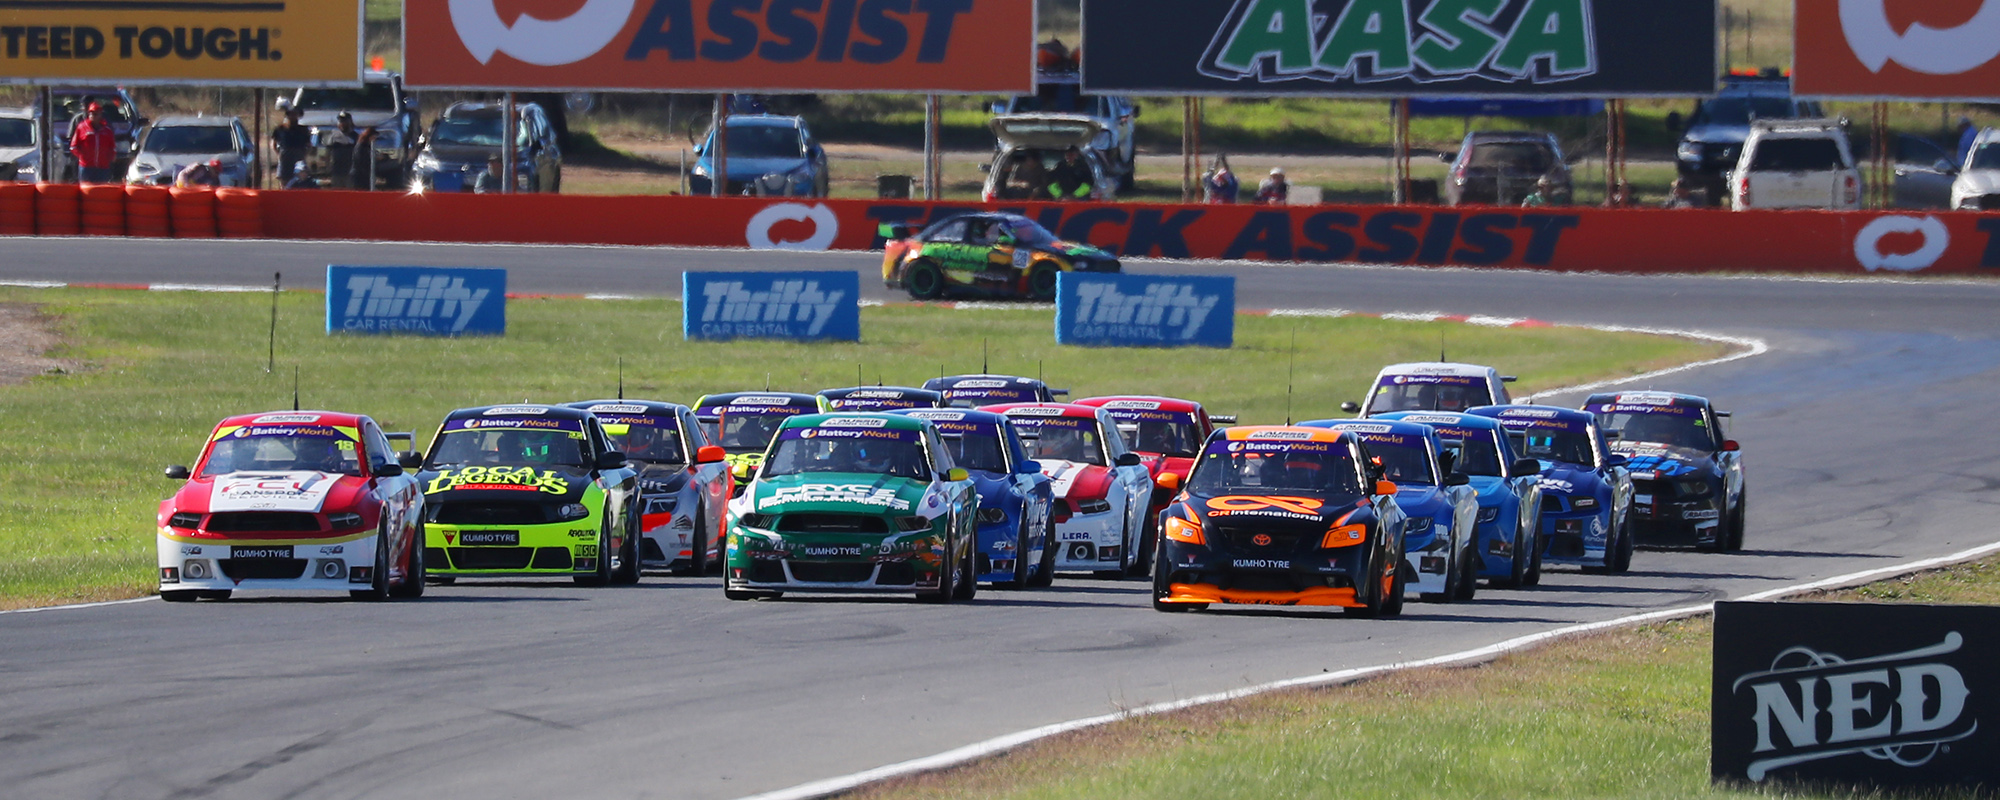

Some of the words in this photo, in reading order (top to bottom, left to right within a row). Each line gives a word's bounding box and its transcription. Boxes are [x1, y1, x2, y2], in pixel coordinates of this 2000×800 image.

[624, 0, 973, 64] ASSIST
[1197, 0, 1597, 83] AASA
[865, 205, 1206, 258] TCK
[1226, 210, 1581, 266] ASSIST
[345, 274, 490, 332] Thrifty
[701, 281, 845, 336] Thrifty
[1074, 282, 1220, 340] Thrifty
[344, 319, 374, 331] CAR
[379, 319, 436, 332] RENTAL
[702, 323, 732, 336] CAR
[735, 323, 792, 337] RENTAL
[1073, 324, 1103, 338] CAR
[1109, 325, 1164, 341] RENTAL
[1010, 418, 1078, 427] atteryWorld
[335, 440, 355, 451] 18
[437, 466, 563, 482] LOCAL
[423, 472, 569, 495] LEGENDS
[775, 483, 896, 496] PRYCE
[462, 534, 492, 543] KUMHO
[493, 534, 516, 543] TYRE
[233, 549, 267, 558] KUMHO
[267, 549, 290, 558] TYRE
[805, 548, 838, 556] KUMHO
[839, 548, 861, 556] TYRE
[1233, 559, 1266, 568] KUMHO
[1267, 560, 1290, 569] TYRE
[1751, 663, 1971, 753] NED
